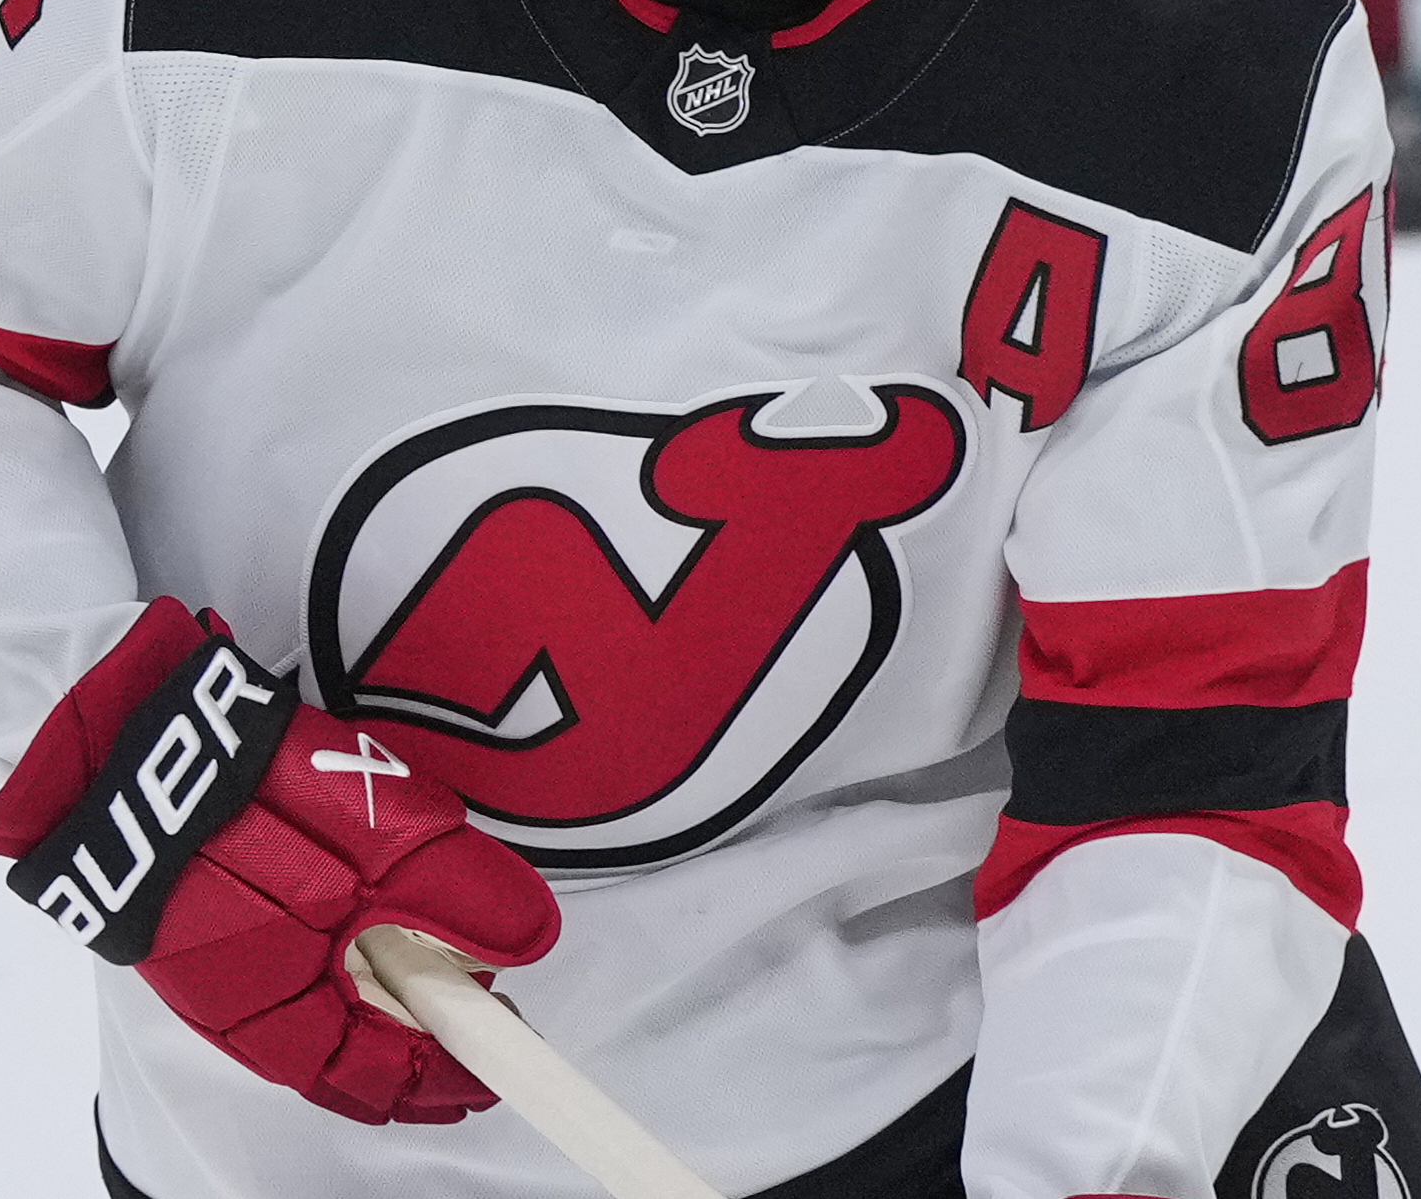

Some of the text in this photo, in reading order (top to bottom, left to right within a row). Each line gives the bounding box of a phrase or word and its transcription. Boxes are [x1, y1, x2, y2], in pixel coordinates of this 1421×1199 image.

[684, 75, 738, 112] NHL
[957, 196, 1109, 434] A
[1237, 176, 1397, 447] 8
[37, 646, 275, 947] AUER
